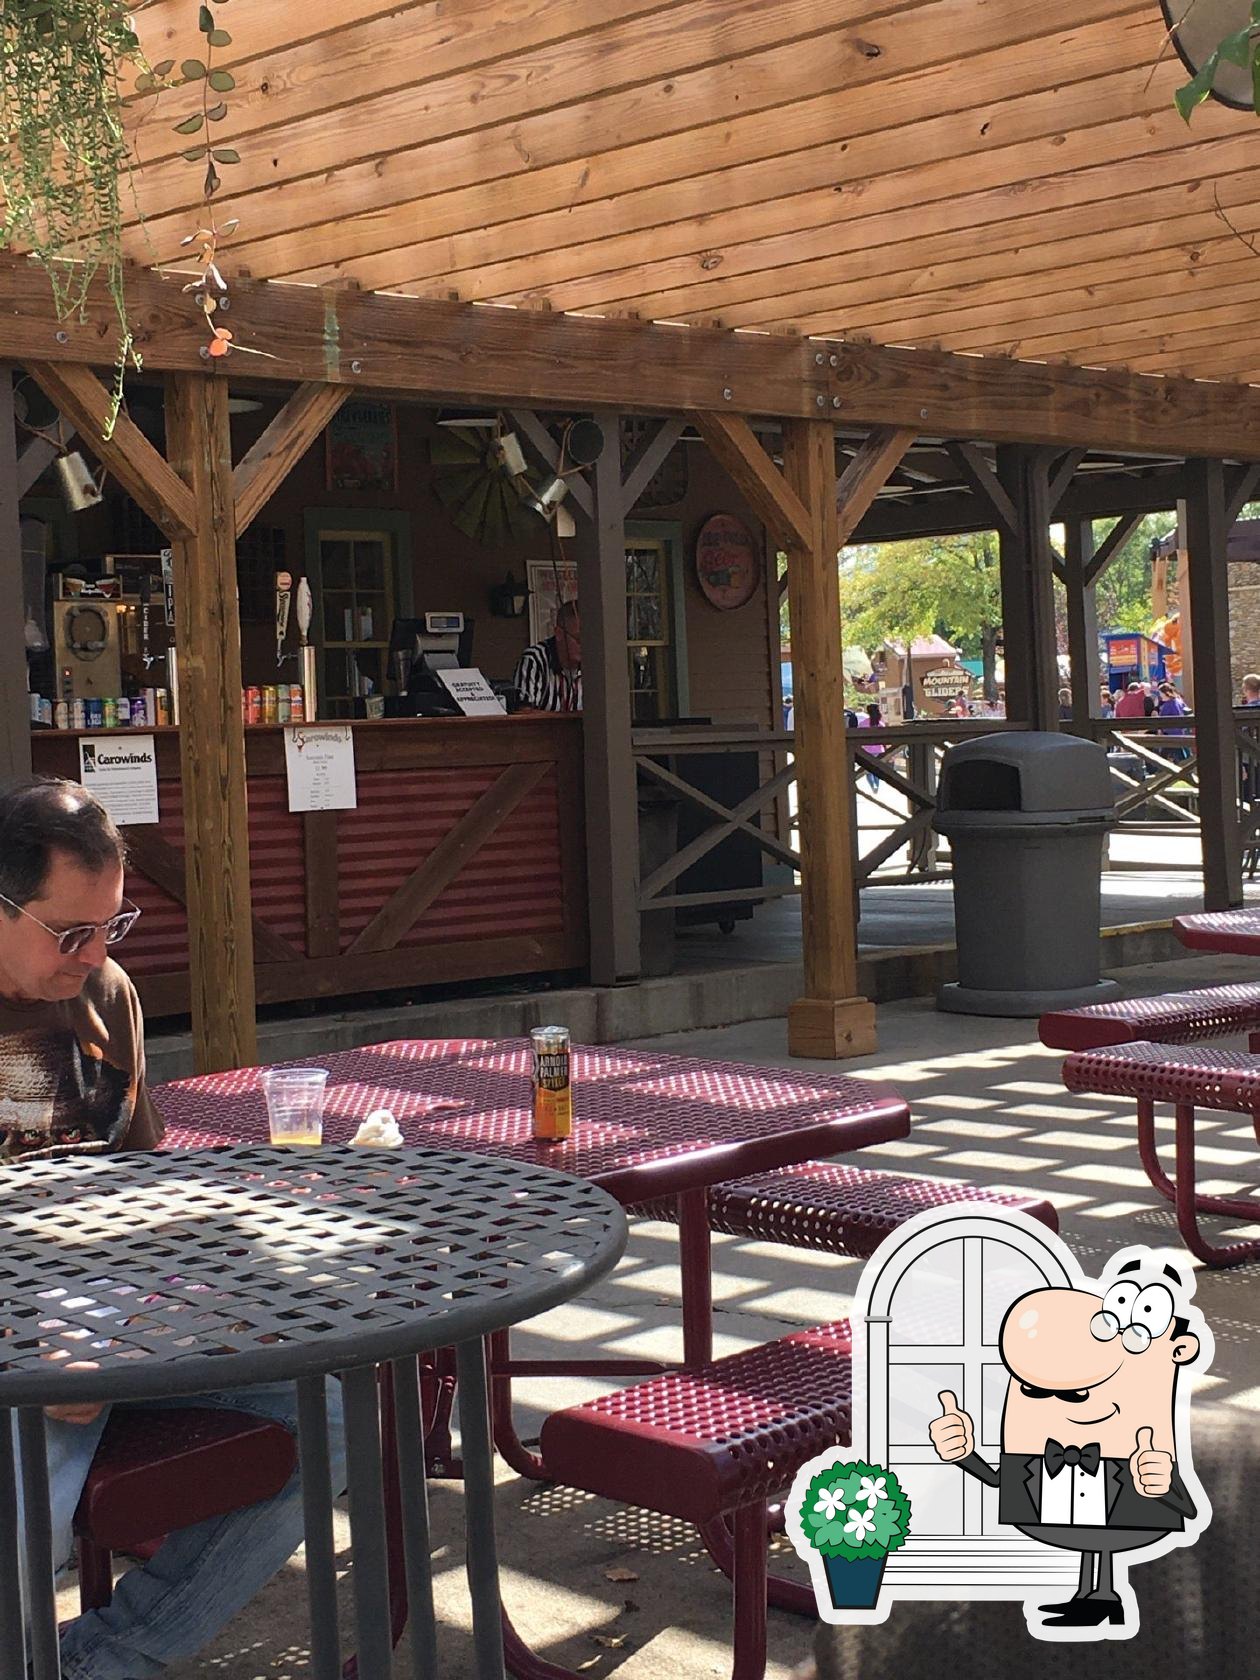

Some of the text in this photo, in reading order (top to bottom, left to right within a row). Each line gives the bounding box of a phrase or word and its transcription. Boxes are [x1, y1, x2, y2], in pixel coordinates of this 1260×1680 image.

[923, 675, 970, 686] MOUNTAIN
[923, 686, 970, 697] GLIDERS
[97, 753, 152, 765] Carowinds
